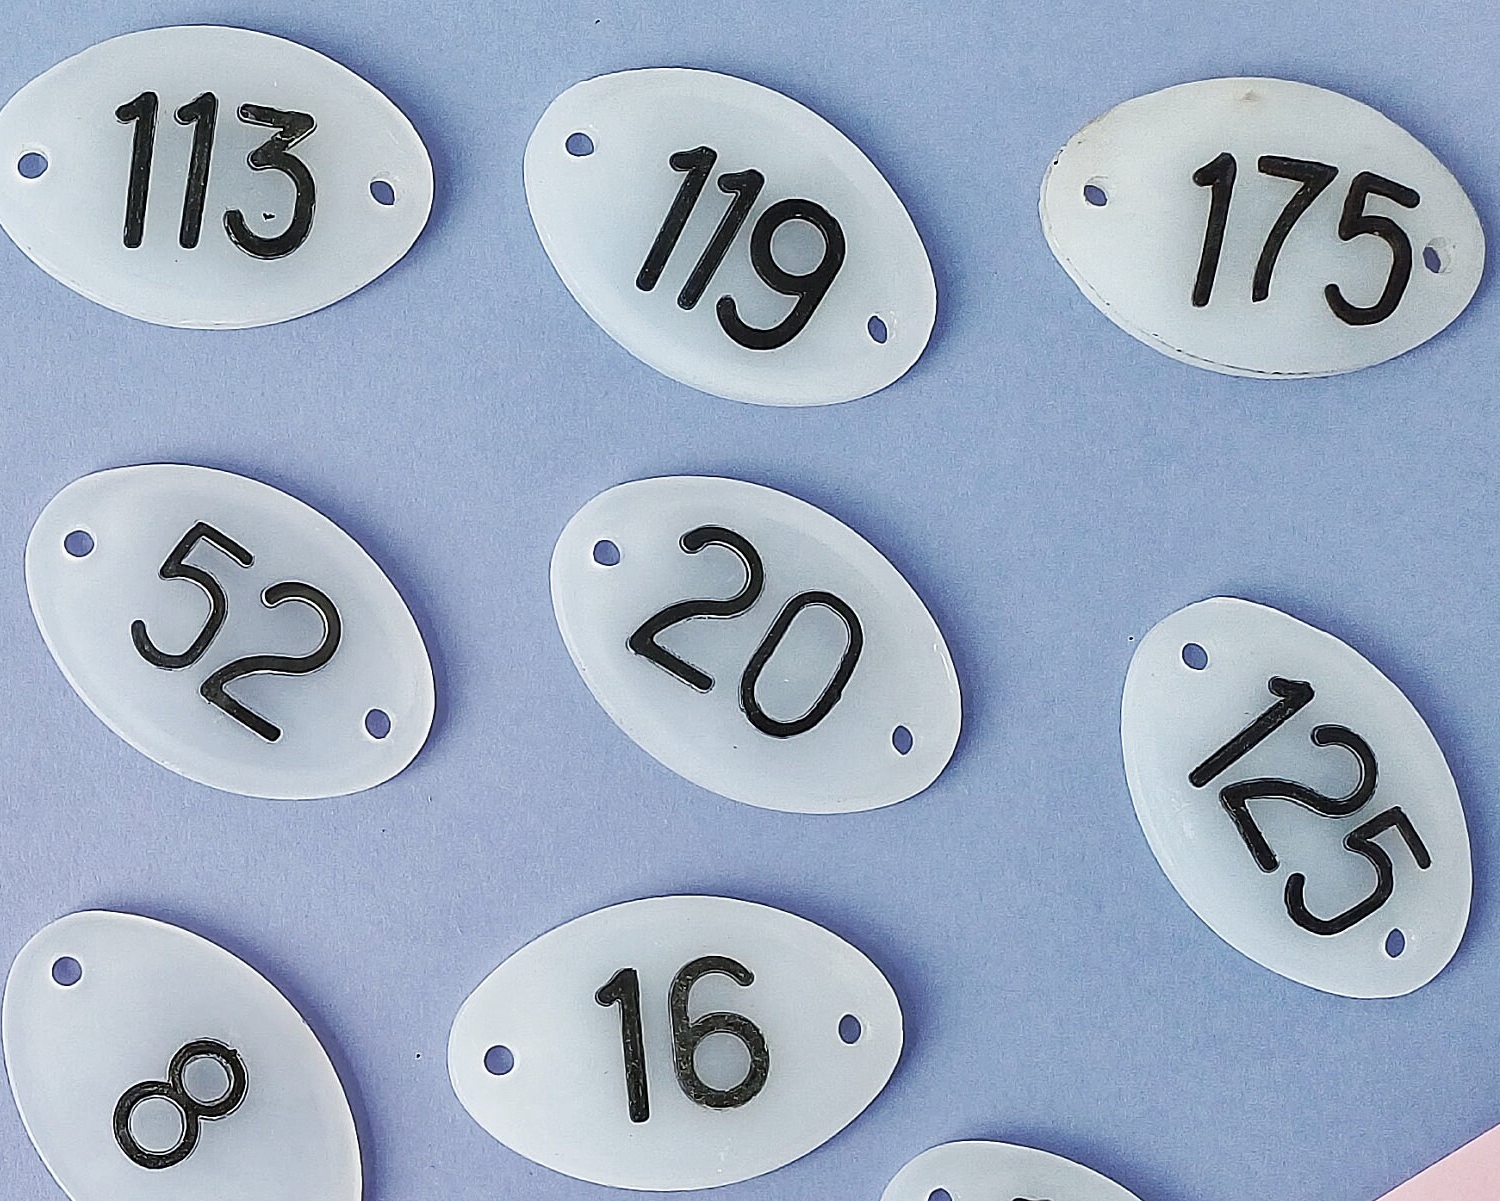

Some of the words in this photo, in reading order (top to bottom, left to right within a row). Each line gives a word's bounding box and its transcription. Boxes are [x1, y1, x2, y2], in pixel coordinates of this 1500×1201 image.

[116, 92, 315, 258] 113
[636, 146, 845, 350] 119
[1193, 153, 1421, 326] 175
[131, 522, 340, 741] 52
[627, 526, 863, 739] 20
[1189, 677, 1431, 936] 125
[113, 1038, 247, 1170] 8
[595, 956, 769, 1122] 16
